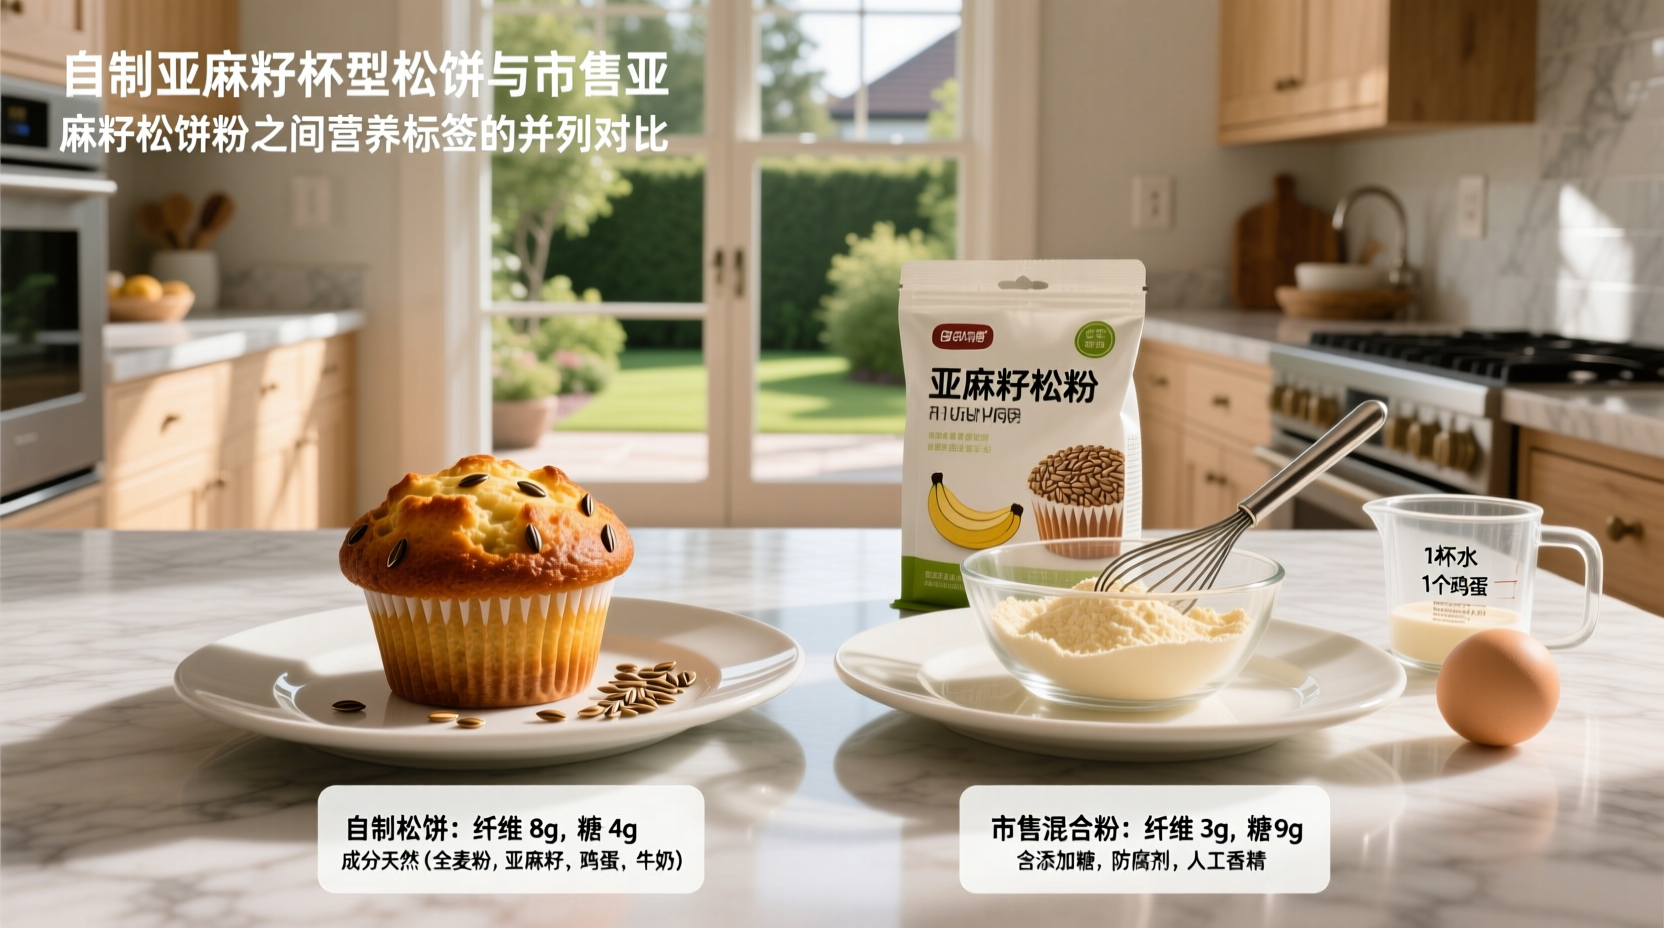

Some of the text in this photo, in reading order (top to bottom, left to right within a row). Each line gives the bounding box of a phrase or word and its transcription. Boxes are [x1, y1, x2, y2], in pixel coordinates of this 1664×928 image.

[928, 367, 1099, 403] 亚麻籽松粉
[1424, 544, 1478, 568] 1杯水
